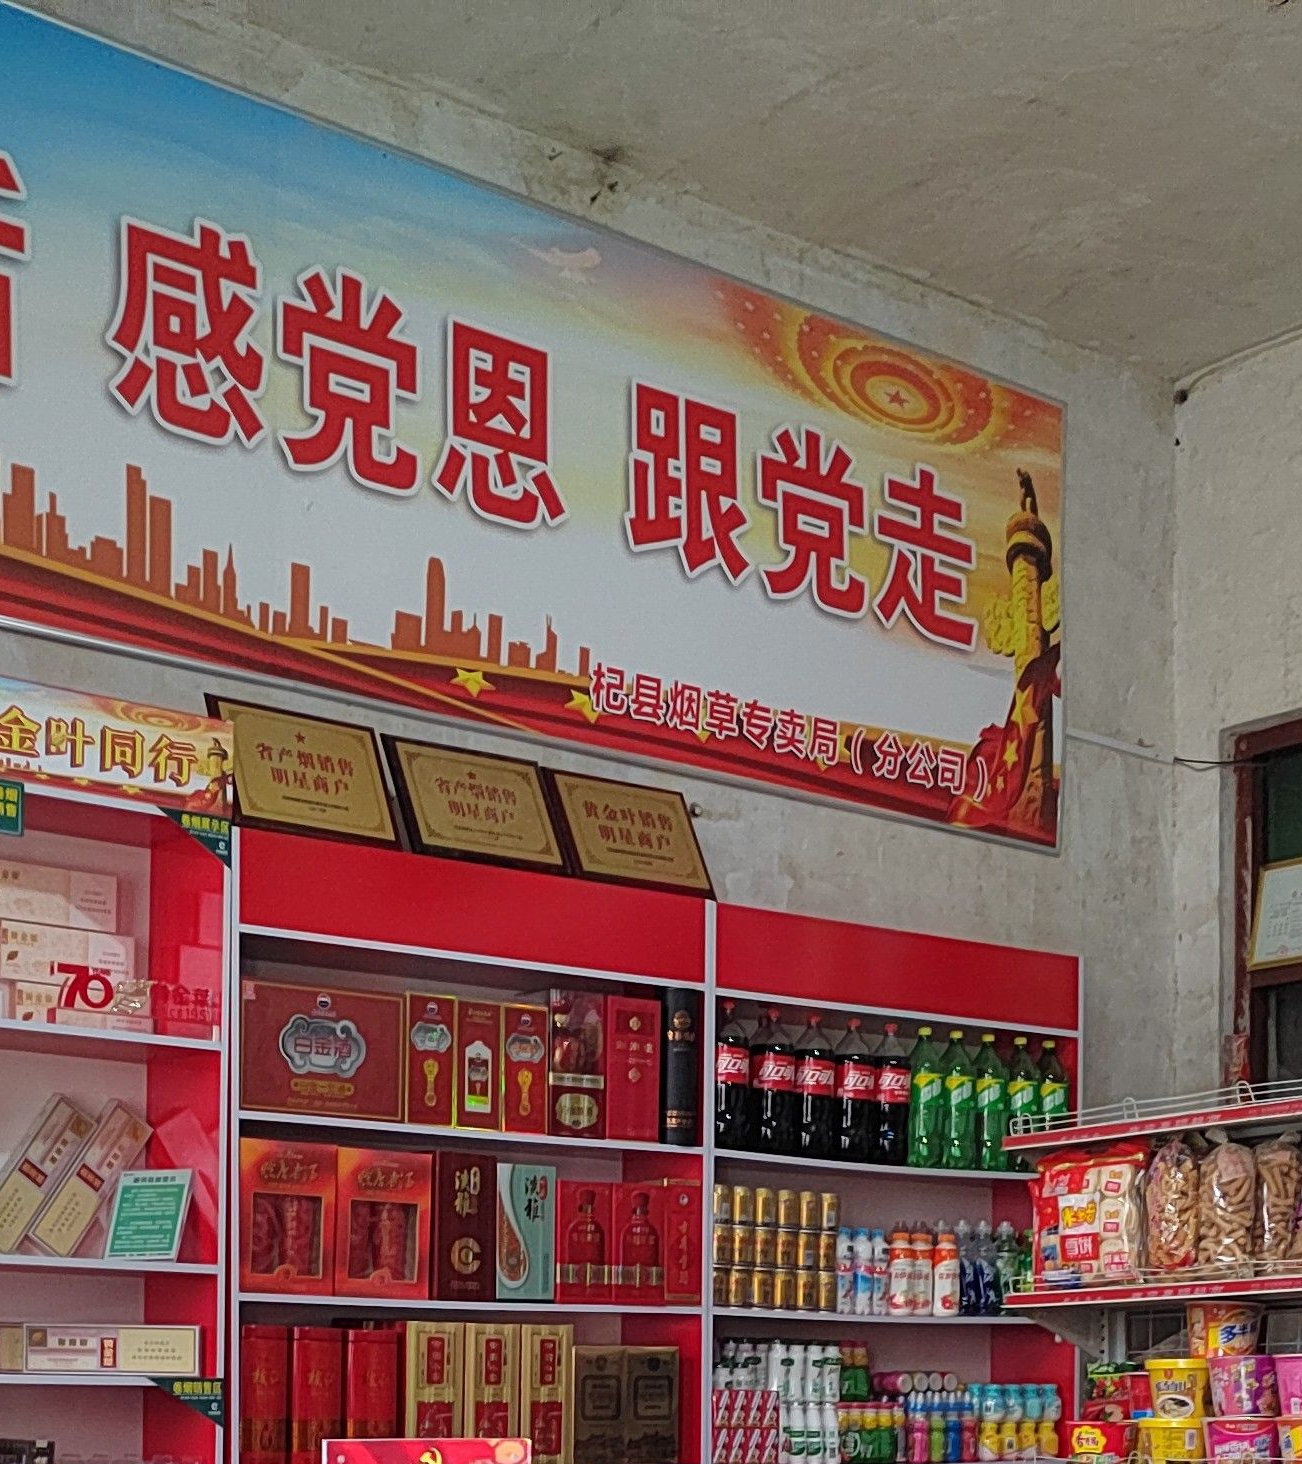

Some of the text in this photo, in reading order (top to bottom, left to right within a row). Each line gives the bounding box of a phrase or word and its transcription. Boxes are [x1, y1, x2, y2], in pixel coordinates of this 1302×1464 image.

[109, 216, 567, 530] 感党恩
[627, 380, 979, 649] 跟党走
